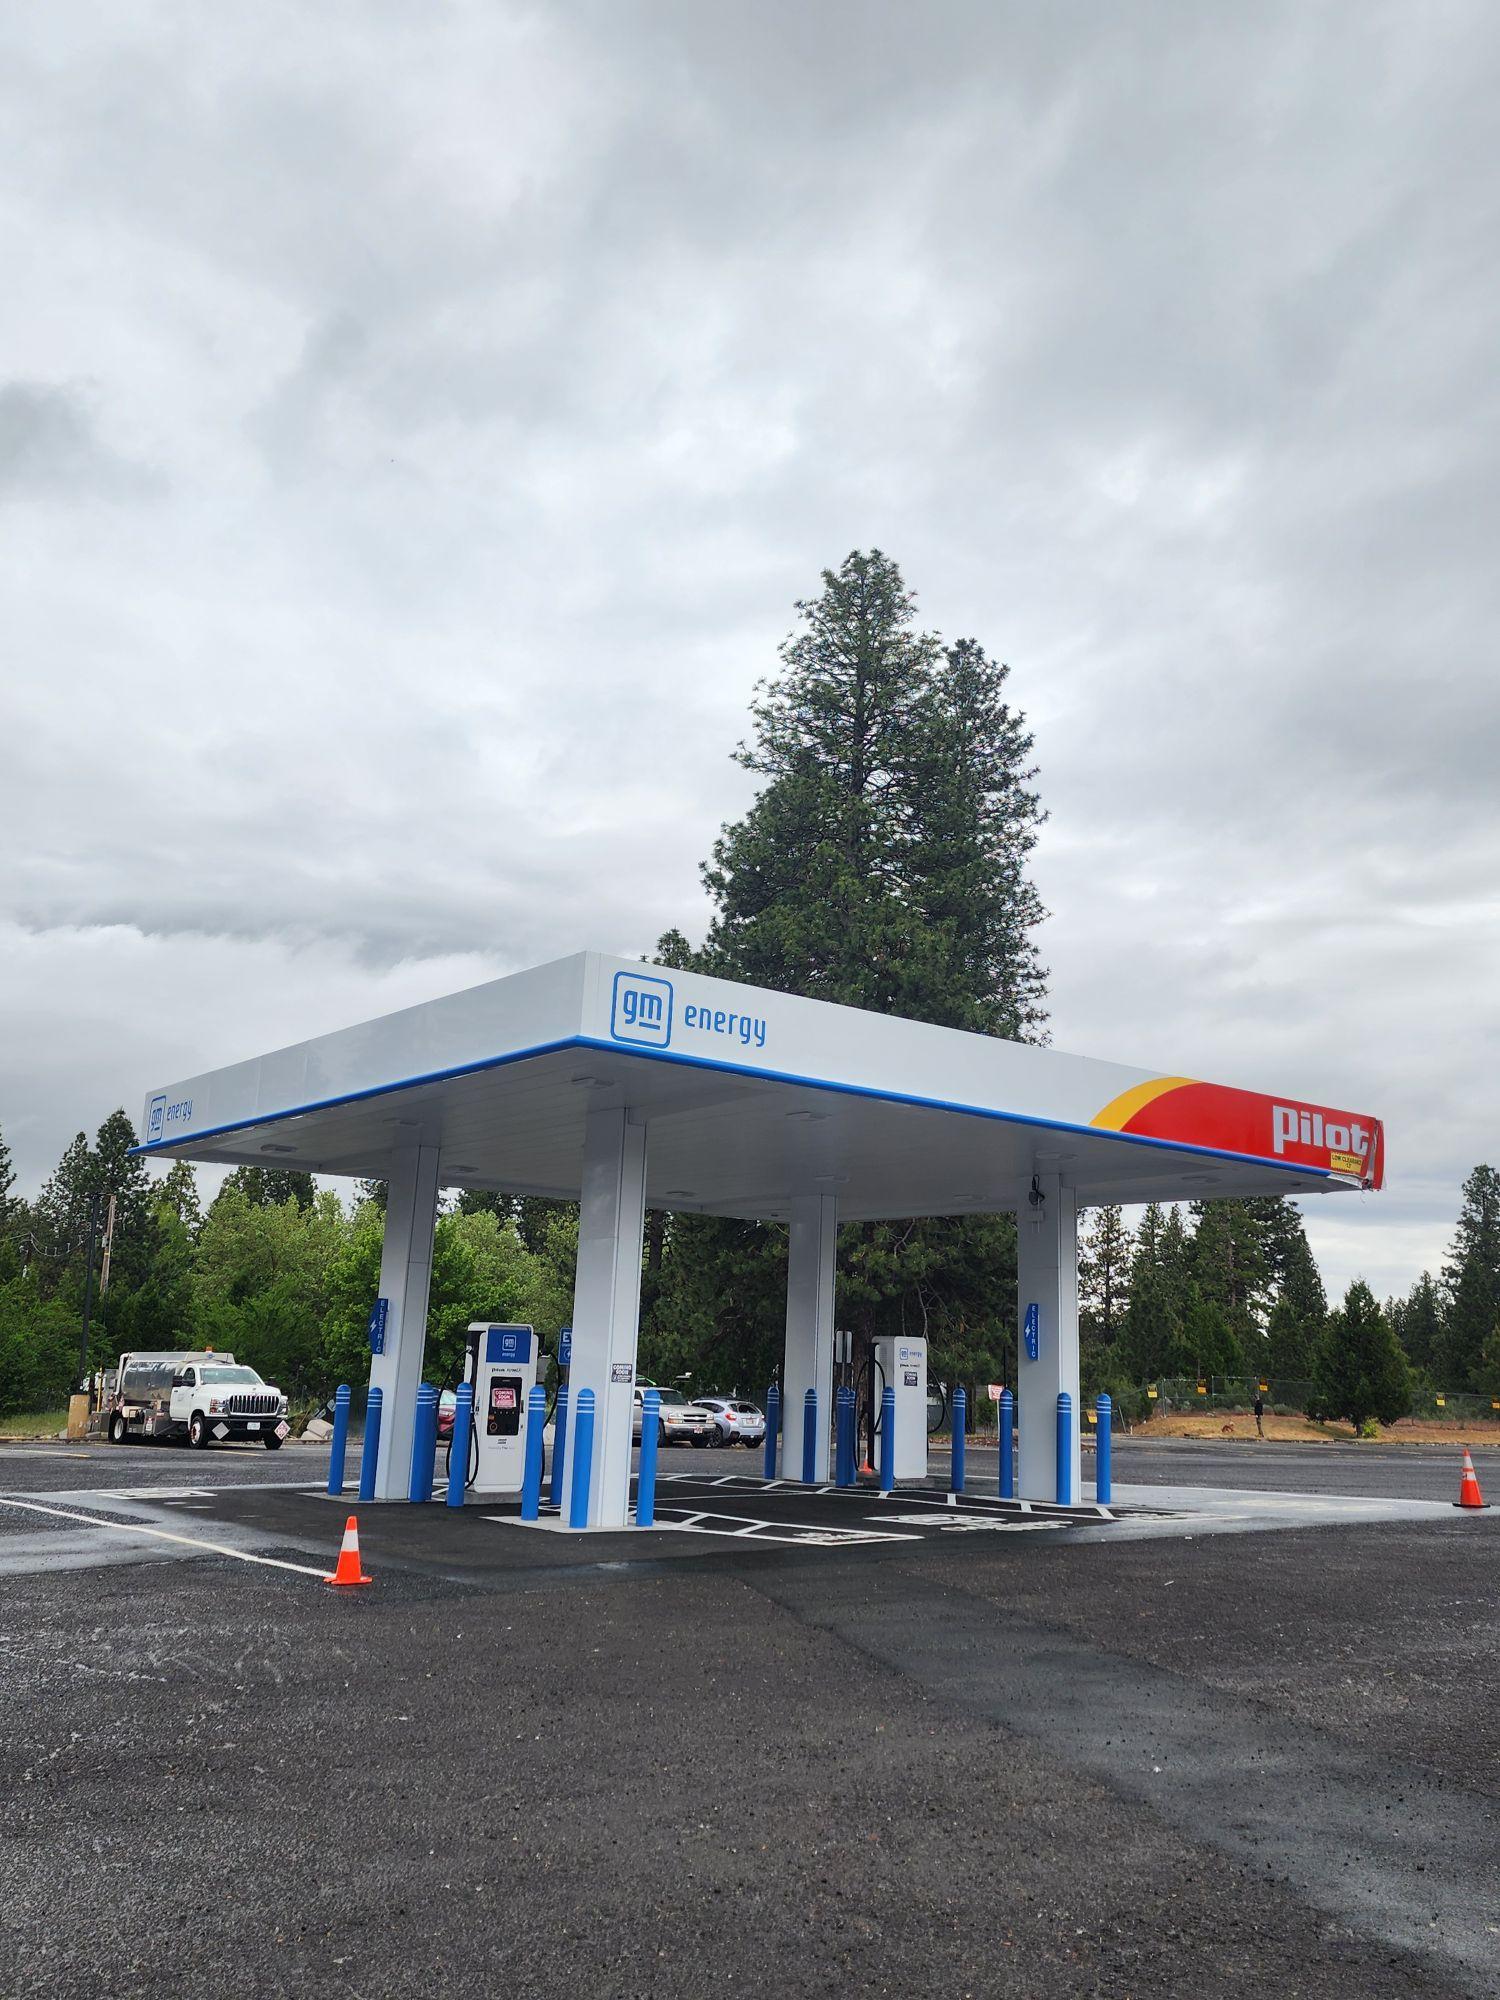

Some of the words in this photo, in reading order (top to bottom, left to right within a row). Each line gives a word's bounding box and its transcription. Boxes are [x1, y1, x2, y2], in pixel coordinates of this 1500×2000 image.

[623, 990, 662, 1030] gm
[685, 1005, 765, 1047] energy
[167, 1100, 192, 1121] energy
[376, 1300, 385, 1352] ELECTRIC
